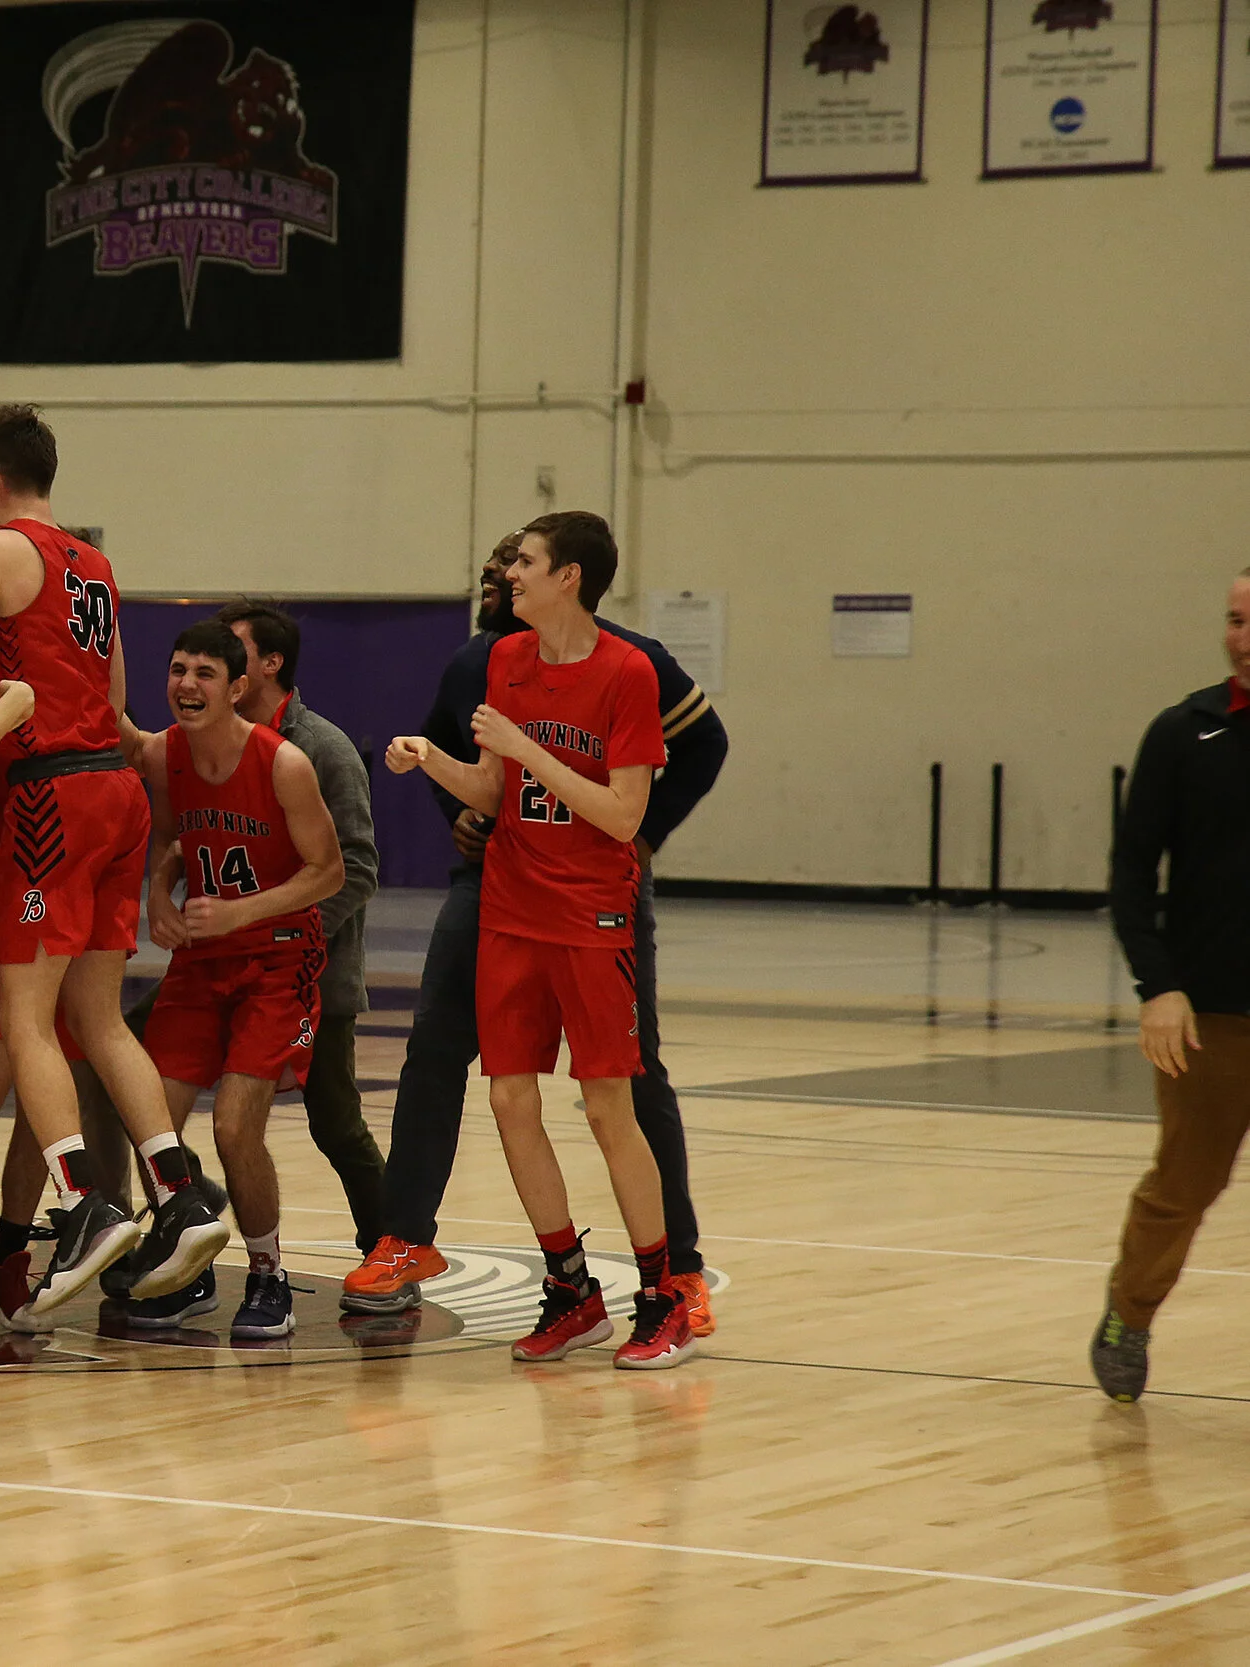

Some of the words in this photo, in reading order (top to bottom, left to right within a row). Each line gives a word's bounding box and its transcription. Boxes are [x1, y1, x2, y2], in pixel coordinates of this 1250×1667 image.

[122, 168, 193, 208] CITY
[100, 218, 285, 281] BEAVERS
[64, 567, 114, 660] 30
[177, 806, 271, 838] BROWNING
[196, 844, 262, 898] 14
[18, 889, 46, 924] B
